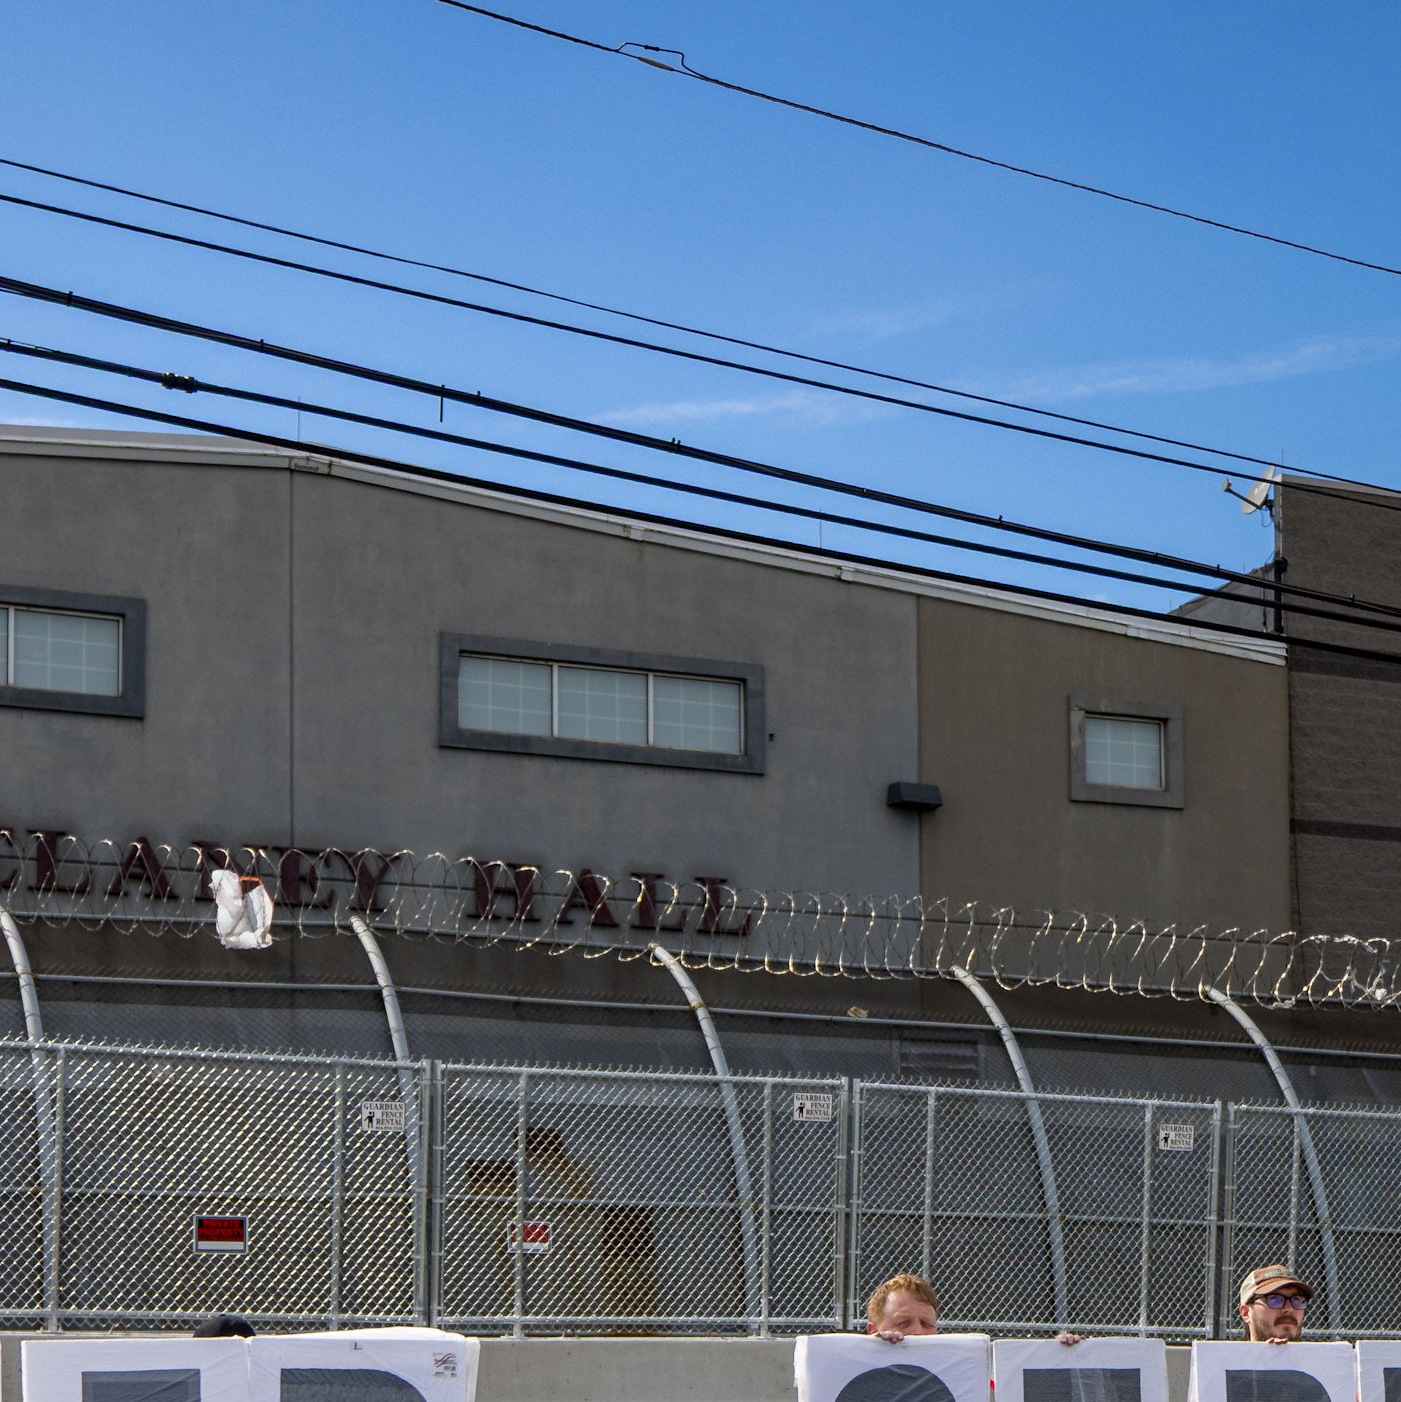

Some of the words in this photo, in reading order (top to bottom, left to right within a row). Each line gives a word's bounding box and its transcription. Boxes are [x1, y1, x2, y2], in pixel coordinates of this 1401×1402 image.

[466, 859, 751, 936] HALL
[796, 1094, 830, 1102] GUARDIAN
[376, 1118, 402, 1126] RENTAL
